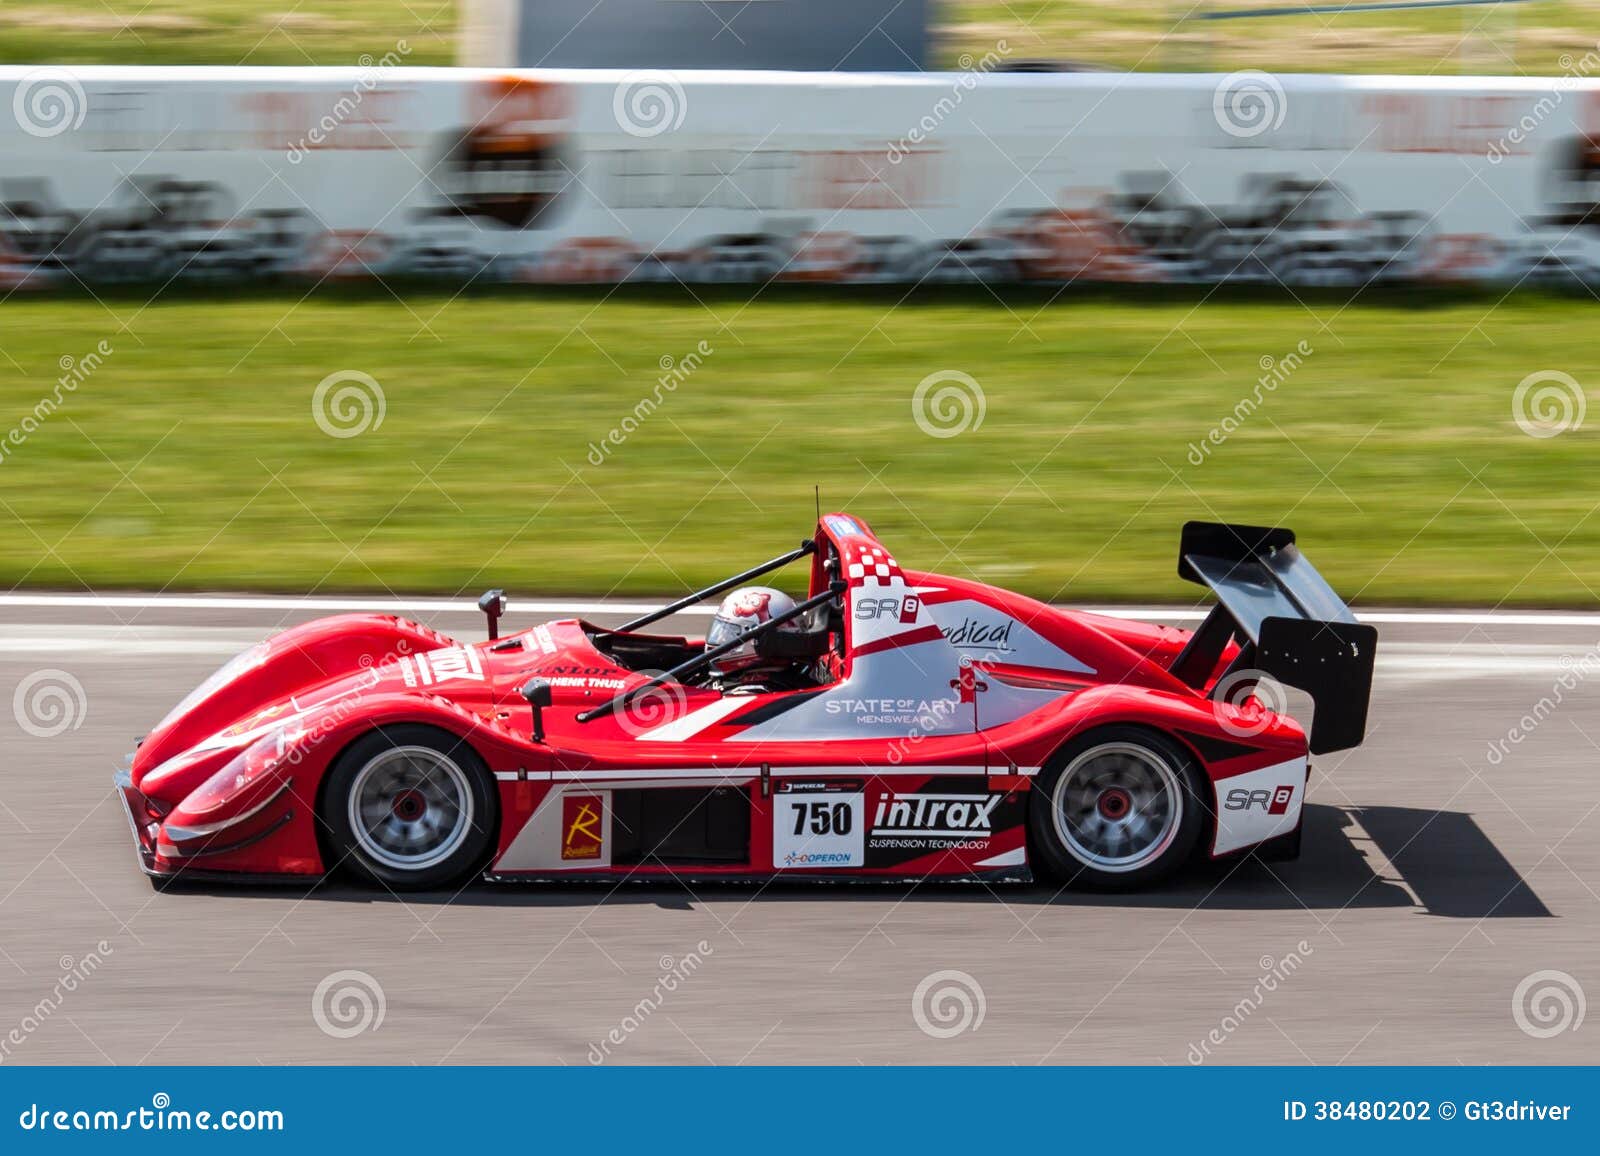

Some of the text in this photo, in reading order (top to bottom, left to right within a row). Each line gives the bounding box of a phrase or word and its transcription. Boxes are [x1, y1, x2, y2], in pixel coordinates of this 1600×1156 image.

[941, 617, 1014, 644] adical
[551, 677, 626, 689] HENK THUIS
[825, 699, 894, 714] STATE
[896, 700, 914, 708] OF
[1224, 785, 1294, 814] SR8
[791, 802, 852, 836] 750
[869, 839, 990, 850] SUSPENSION TECHNOLOGY
